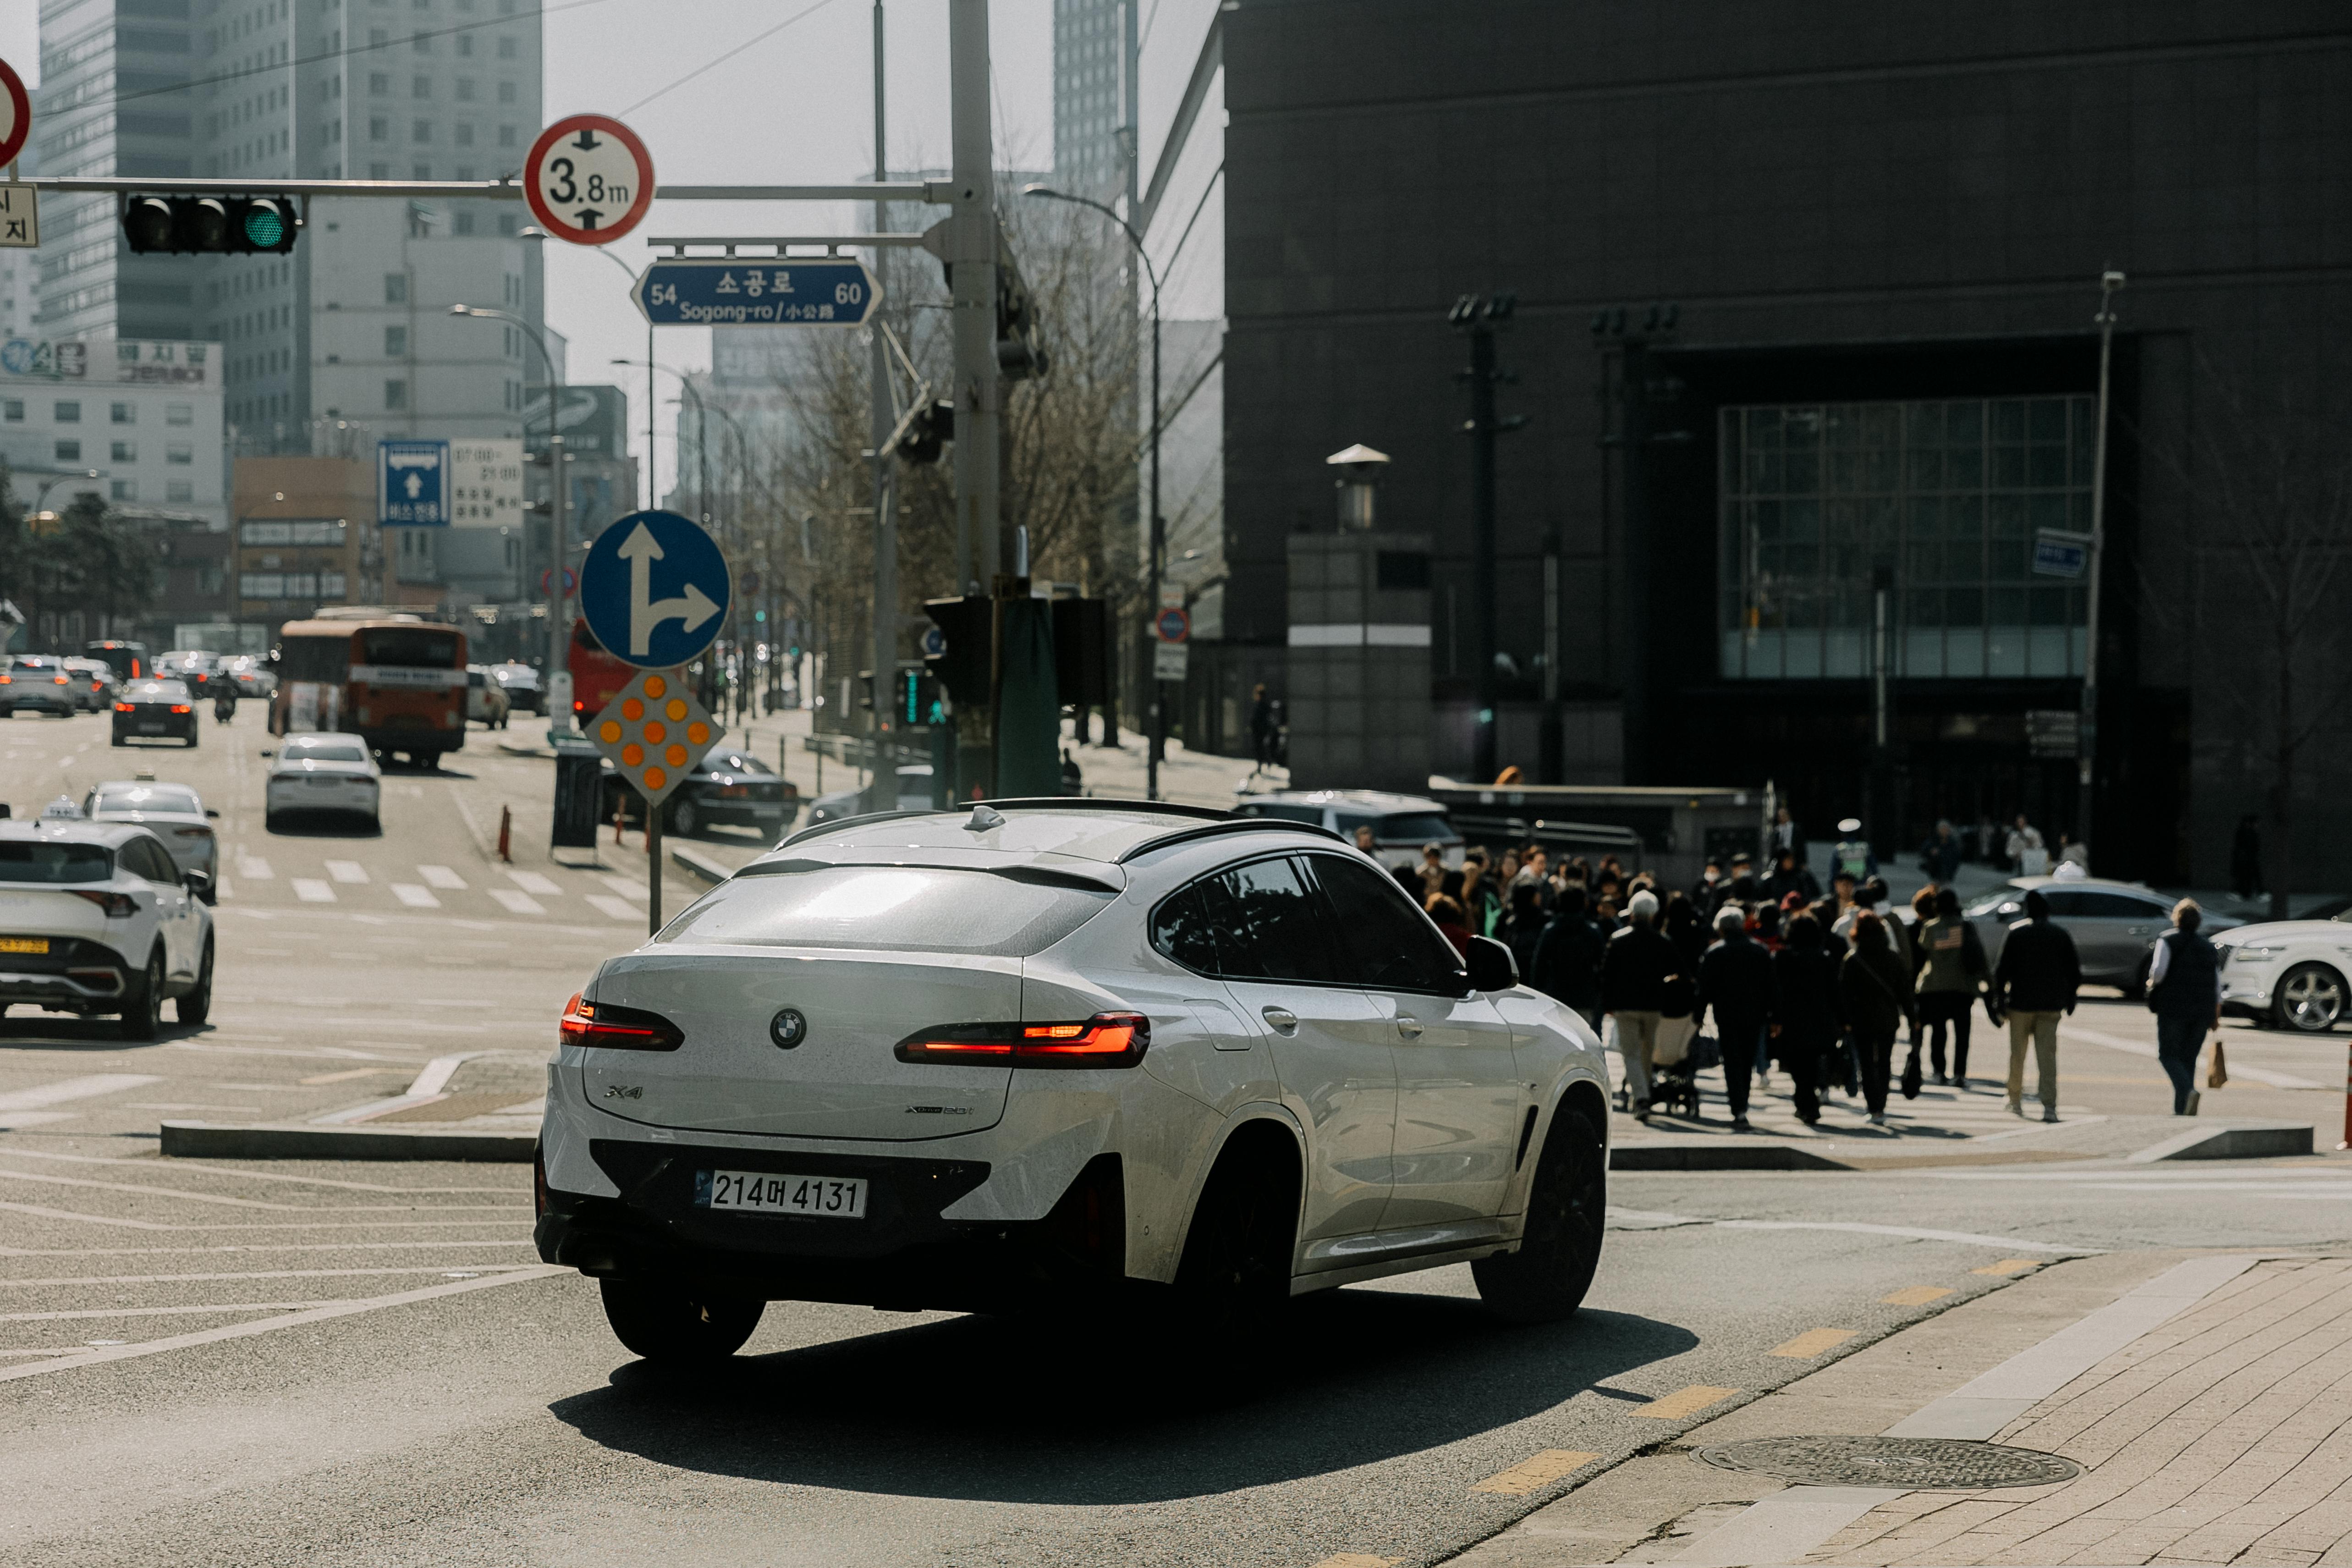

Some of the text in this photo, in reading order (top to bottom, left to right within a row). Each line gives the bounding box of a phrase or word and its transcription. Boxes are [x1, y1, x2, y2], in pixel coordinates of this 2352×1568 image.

[550, 157, 628, 204] 3.8m
[715, 270, 795, 297] 소공로
[835, 282, 862, 304] 60
[650, 284, 677, 306] 54
[777, 1013, 800, 1024] BMW
[604, 1085, 643, 1100] X4
[944, 1106, 975, 1115] 20i
[714, 1175, 857, 1212] 214머 4131
